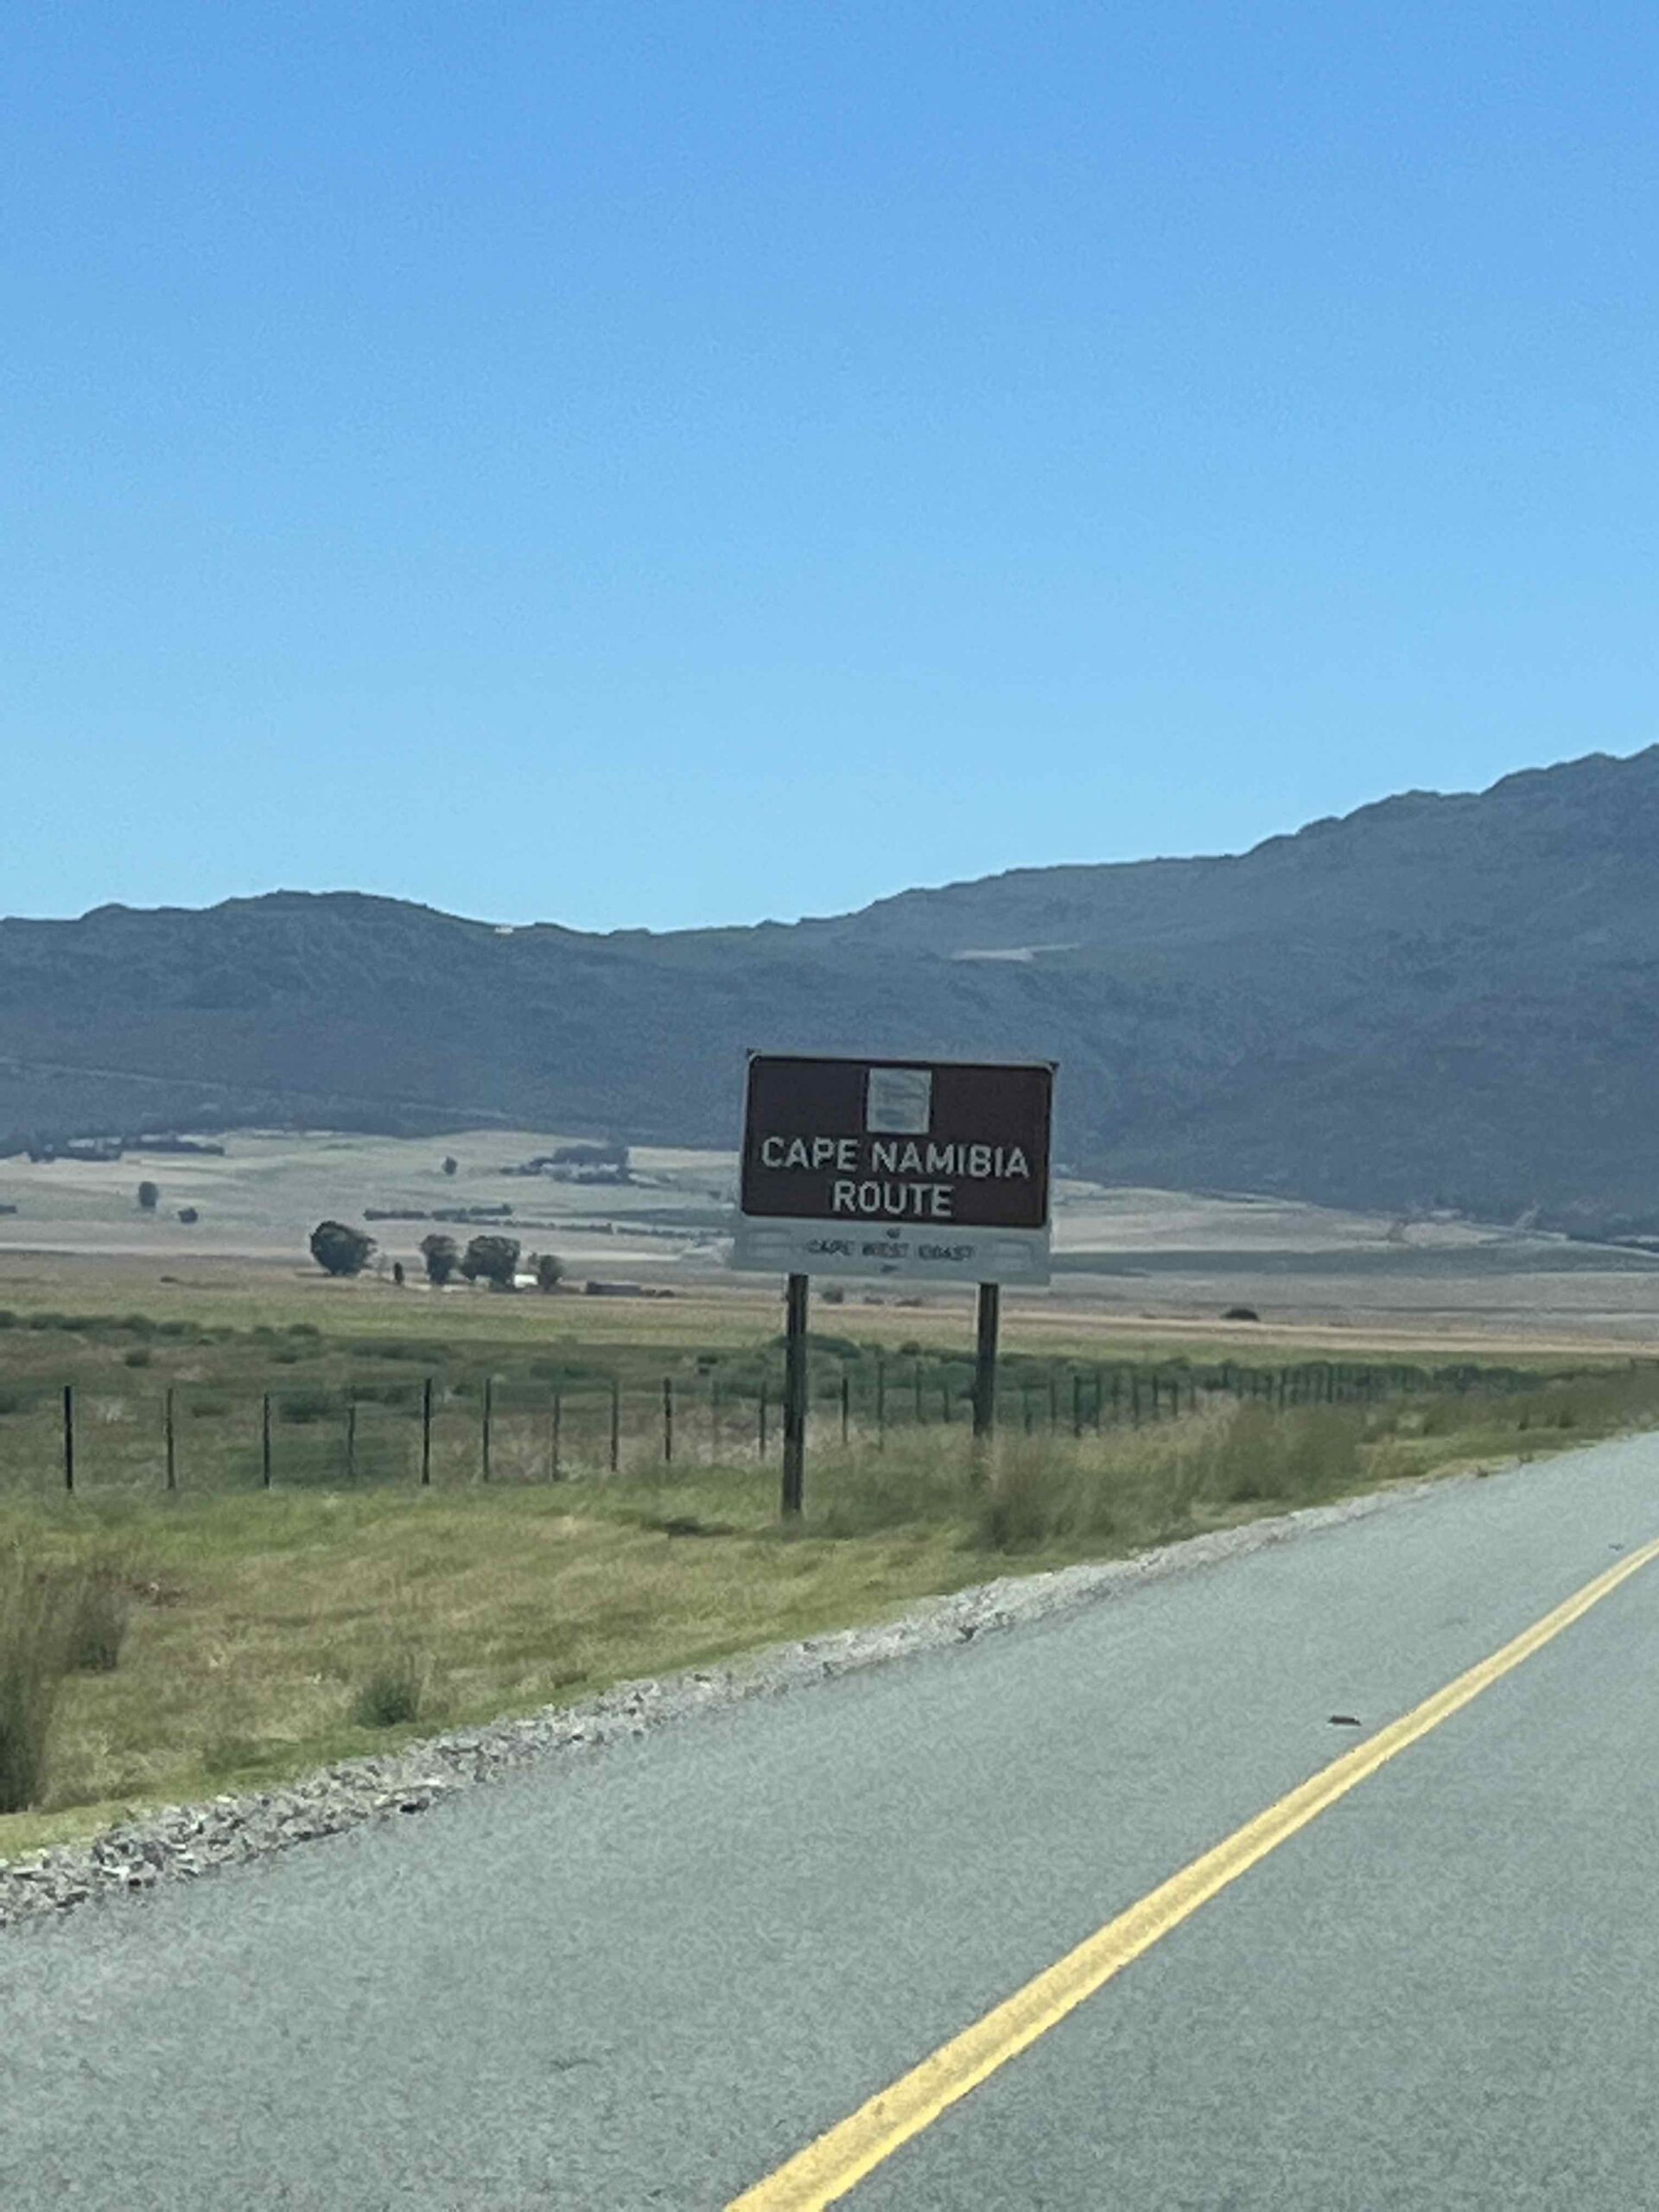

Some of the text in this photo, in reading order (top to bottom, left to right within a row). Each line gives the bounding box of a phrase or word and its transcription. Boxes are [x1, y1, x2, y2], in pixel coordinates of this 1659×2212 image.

[760, 1136, 1030, 1179] CAPE NAMIBIA
[832, 1180, 952, 1217] ROUTE
